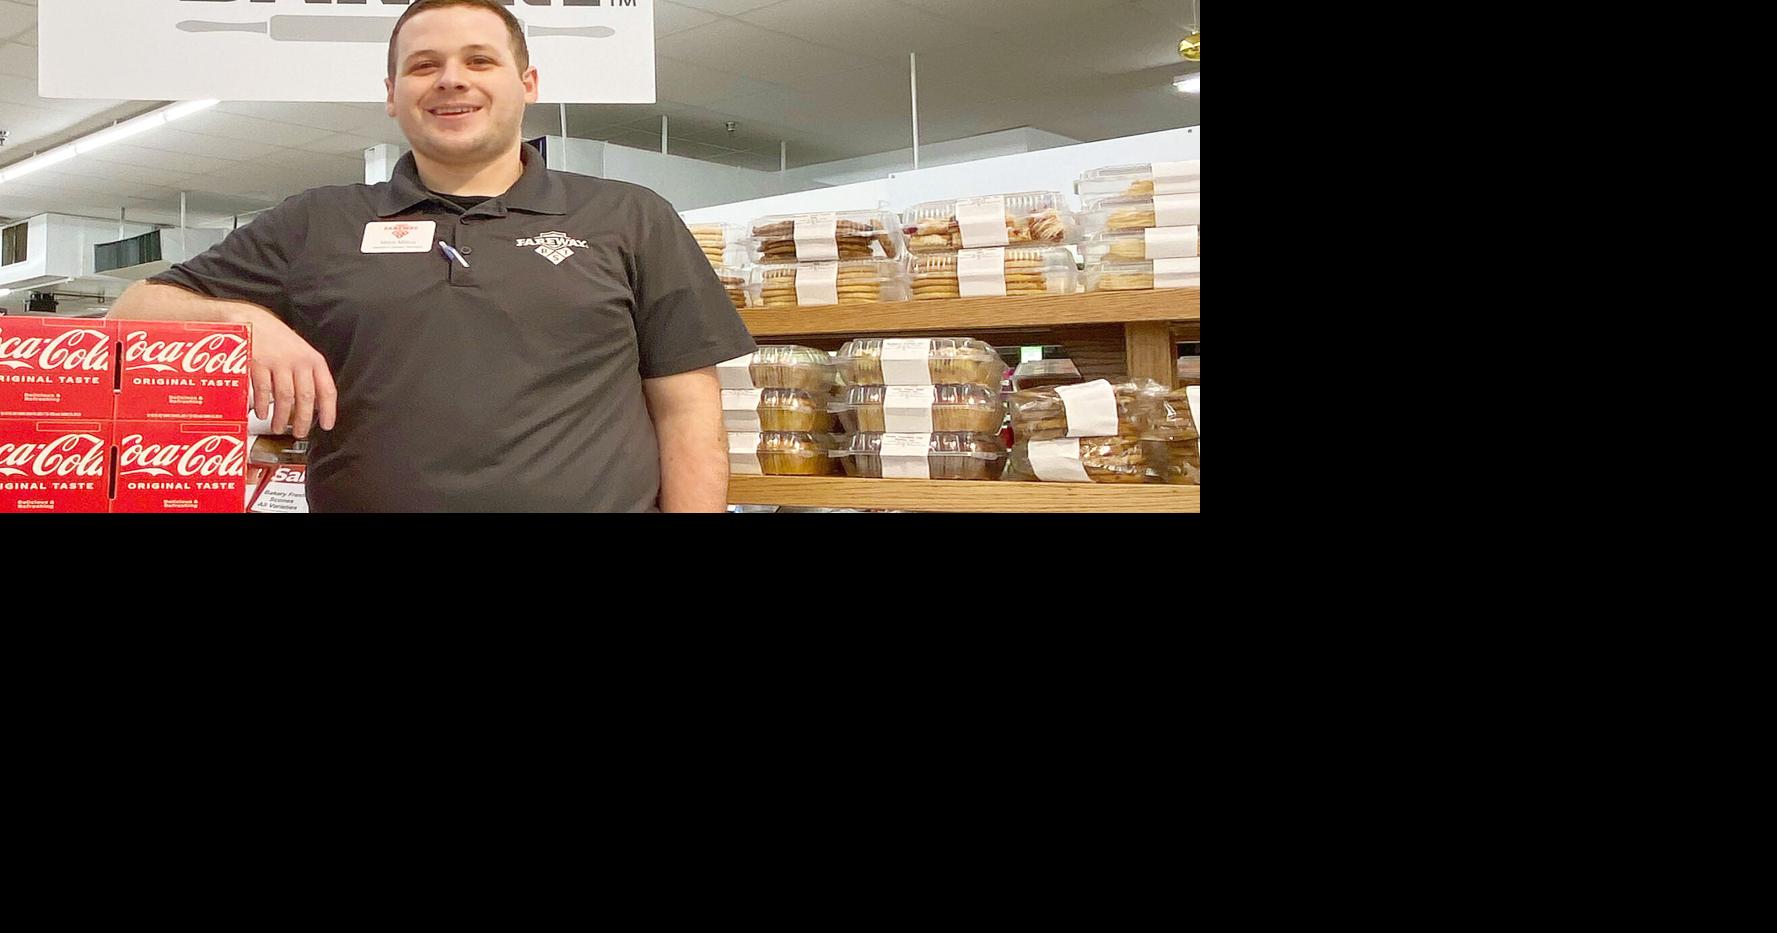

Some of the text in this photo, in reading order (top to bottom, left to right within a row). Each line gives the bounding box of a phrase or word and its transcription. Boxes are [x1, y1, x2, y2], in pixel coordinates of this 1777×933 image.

[516, 237, 588, 248] FAREWAY
[0, 375, 100, 384] RIGINAL TASTE
[133, 378, 239, 387] ORIGINAL TASTE
[271, 467, 305, 482] Sal
[52, 482, 94, 490] TASTE
